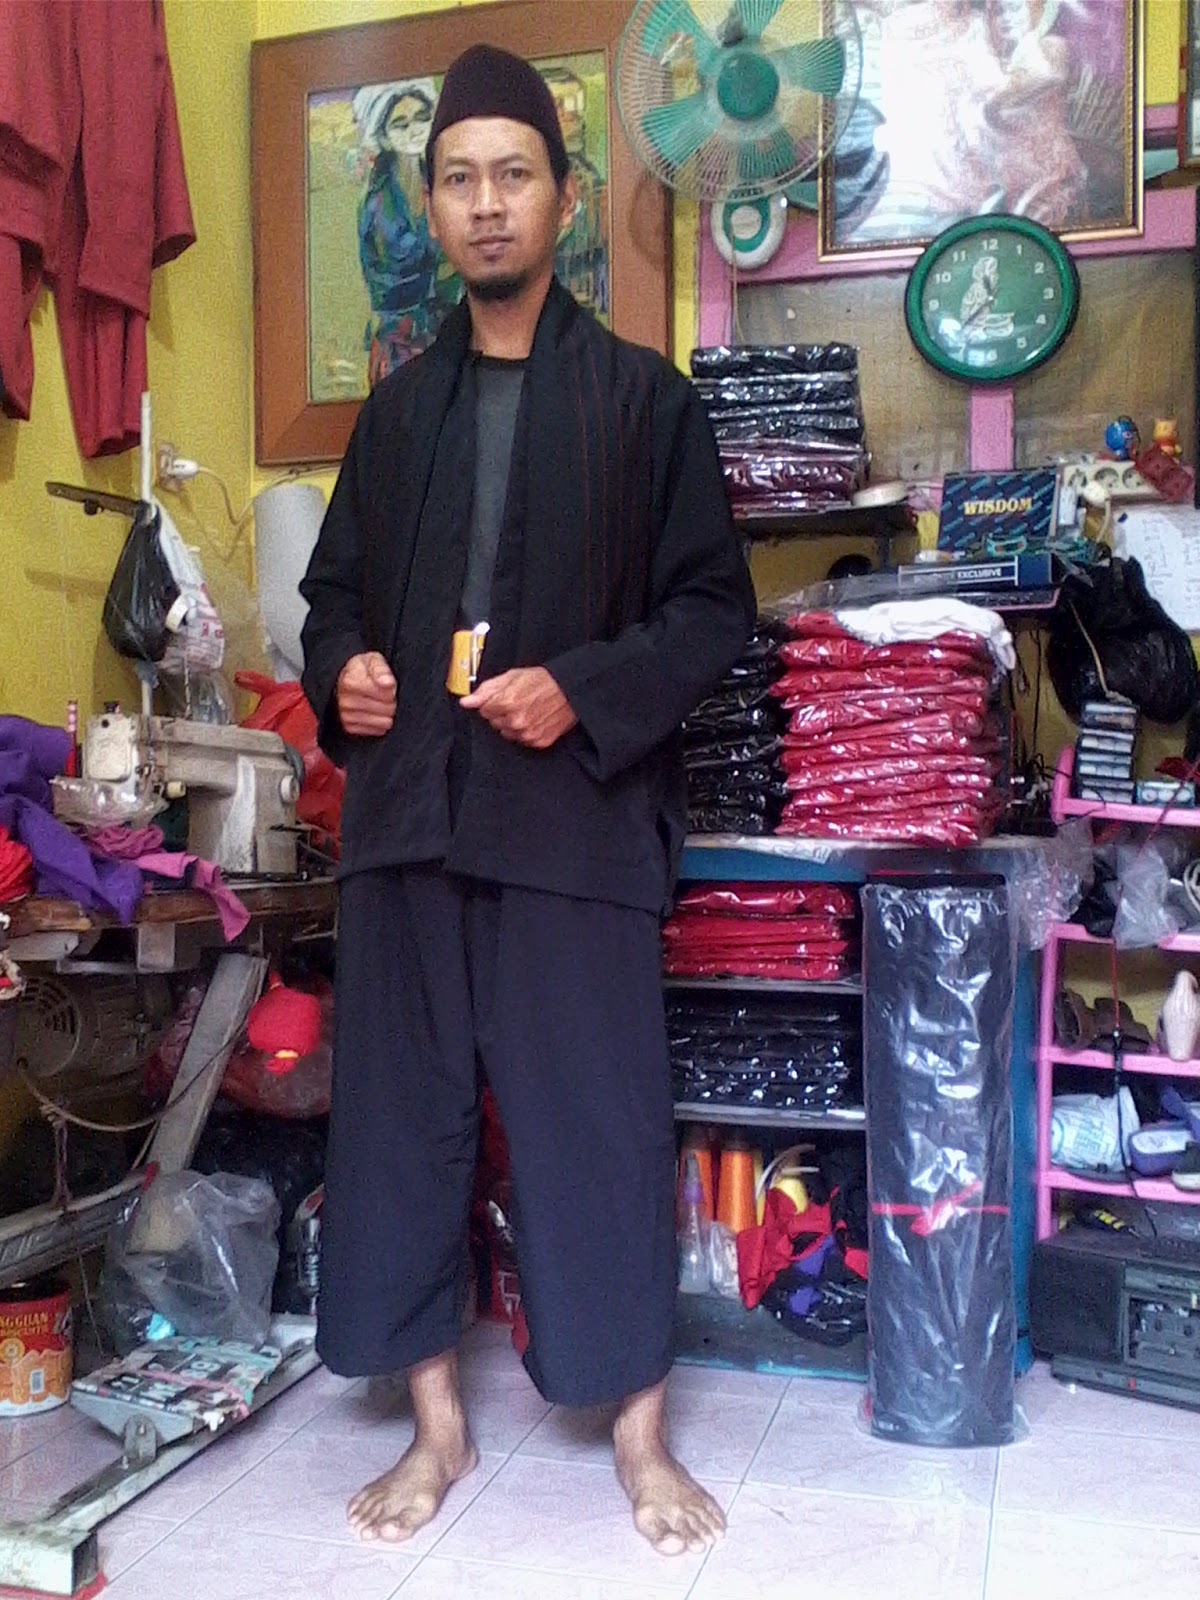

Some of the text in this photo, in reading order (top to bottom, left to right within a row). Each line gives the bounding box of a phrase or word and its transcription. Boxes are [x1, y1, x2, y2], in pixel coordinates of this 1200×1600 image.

[982, 238, 998, 250] 12
[1016, 244, 1022, 255] 1
[953, 250, 966, 262] 11
[1034, 262, 1044, 274] 2
[935, 271, 951, 283] 10
[1043, 287, 1054, 299] 3
[928, 299, 939, 311] 9
[1035, 314, 1046, 326] 4
[1016, 337, 1027, 349] 5
[986, 349, 998, 361] 6
[963, 497, 1032, 516] WISDOM
[957, 568, 1002, 579] EXCLUSIVE
